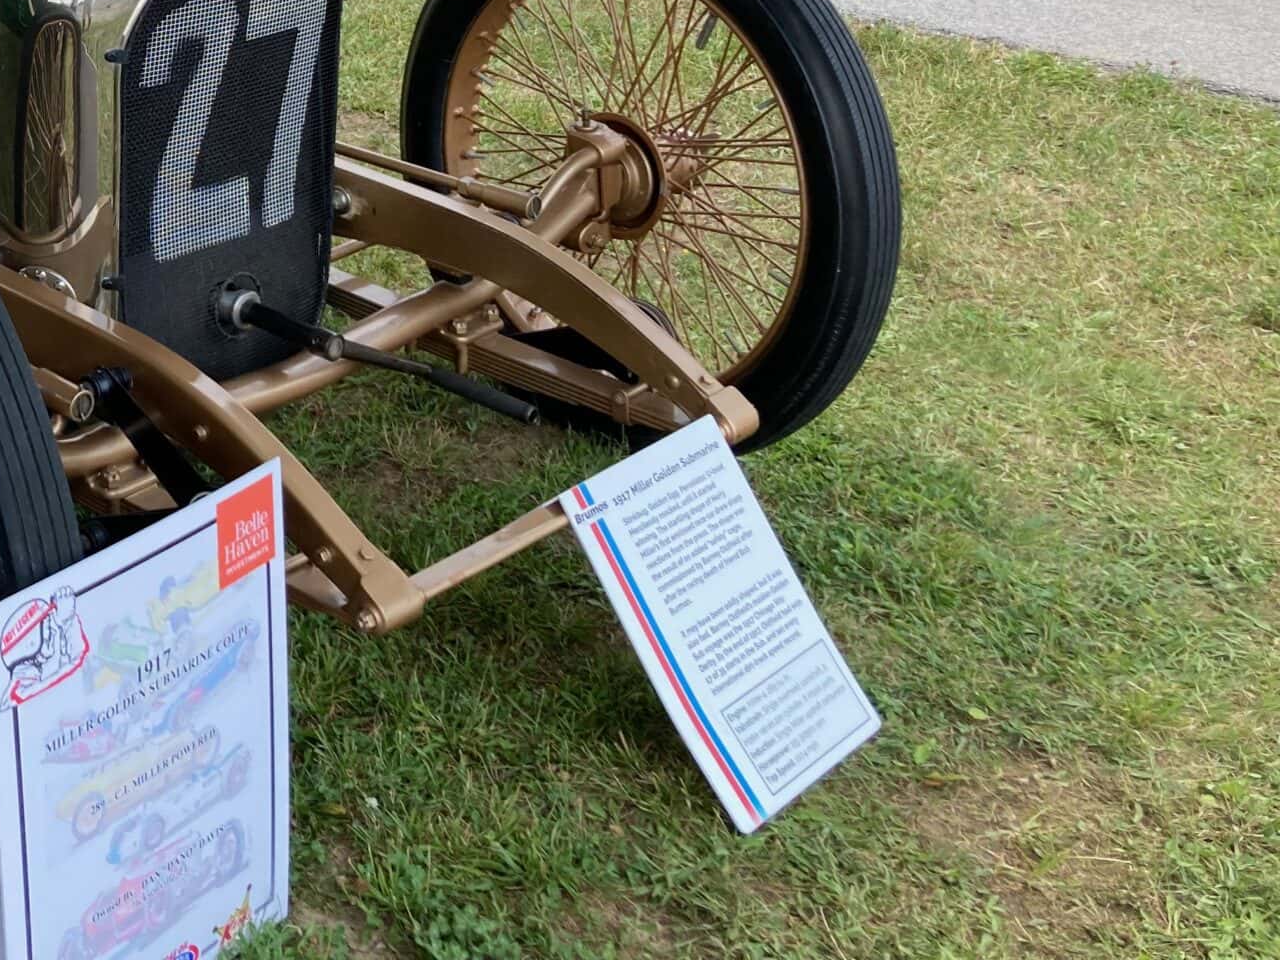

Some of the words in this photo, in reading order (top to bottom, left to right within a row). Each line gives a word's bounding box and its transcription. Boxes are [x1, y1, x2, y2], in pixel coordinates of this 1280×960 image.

[574, 501, 608, 524] Brumos
[612, 490, 630, 506] 1917
[630, 478, 653, 495] Miller
[652, 463, 681, 482] Golden
[679, 441, 719, 467] Submarine
[235, 510, 268, 540] Belle
[224, 527, 269, 564] Haven
[136, 647, 173, 683] 1917
[45, 718, 95, 753] MILLER
[96, 689, 147, 726] GOLDEN
[148, 646, 214, 693] SUBMARINE
[131, 758, 170, 788] MILLER
